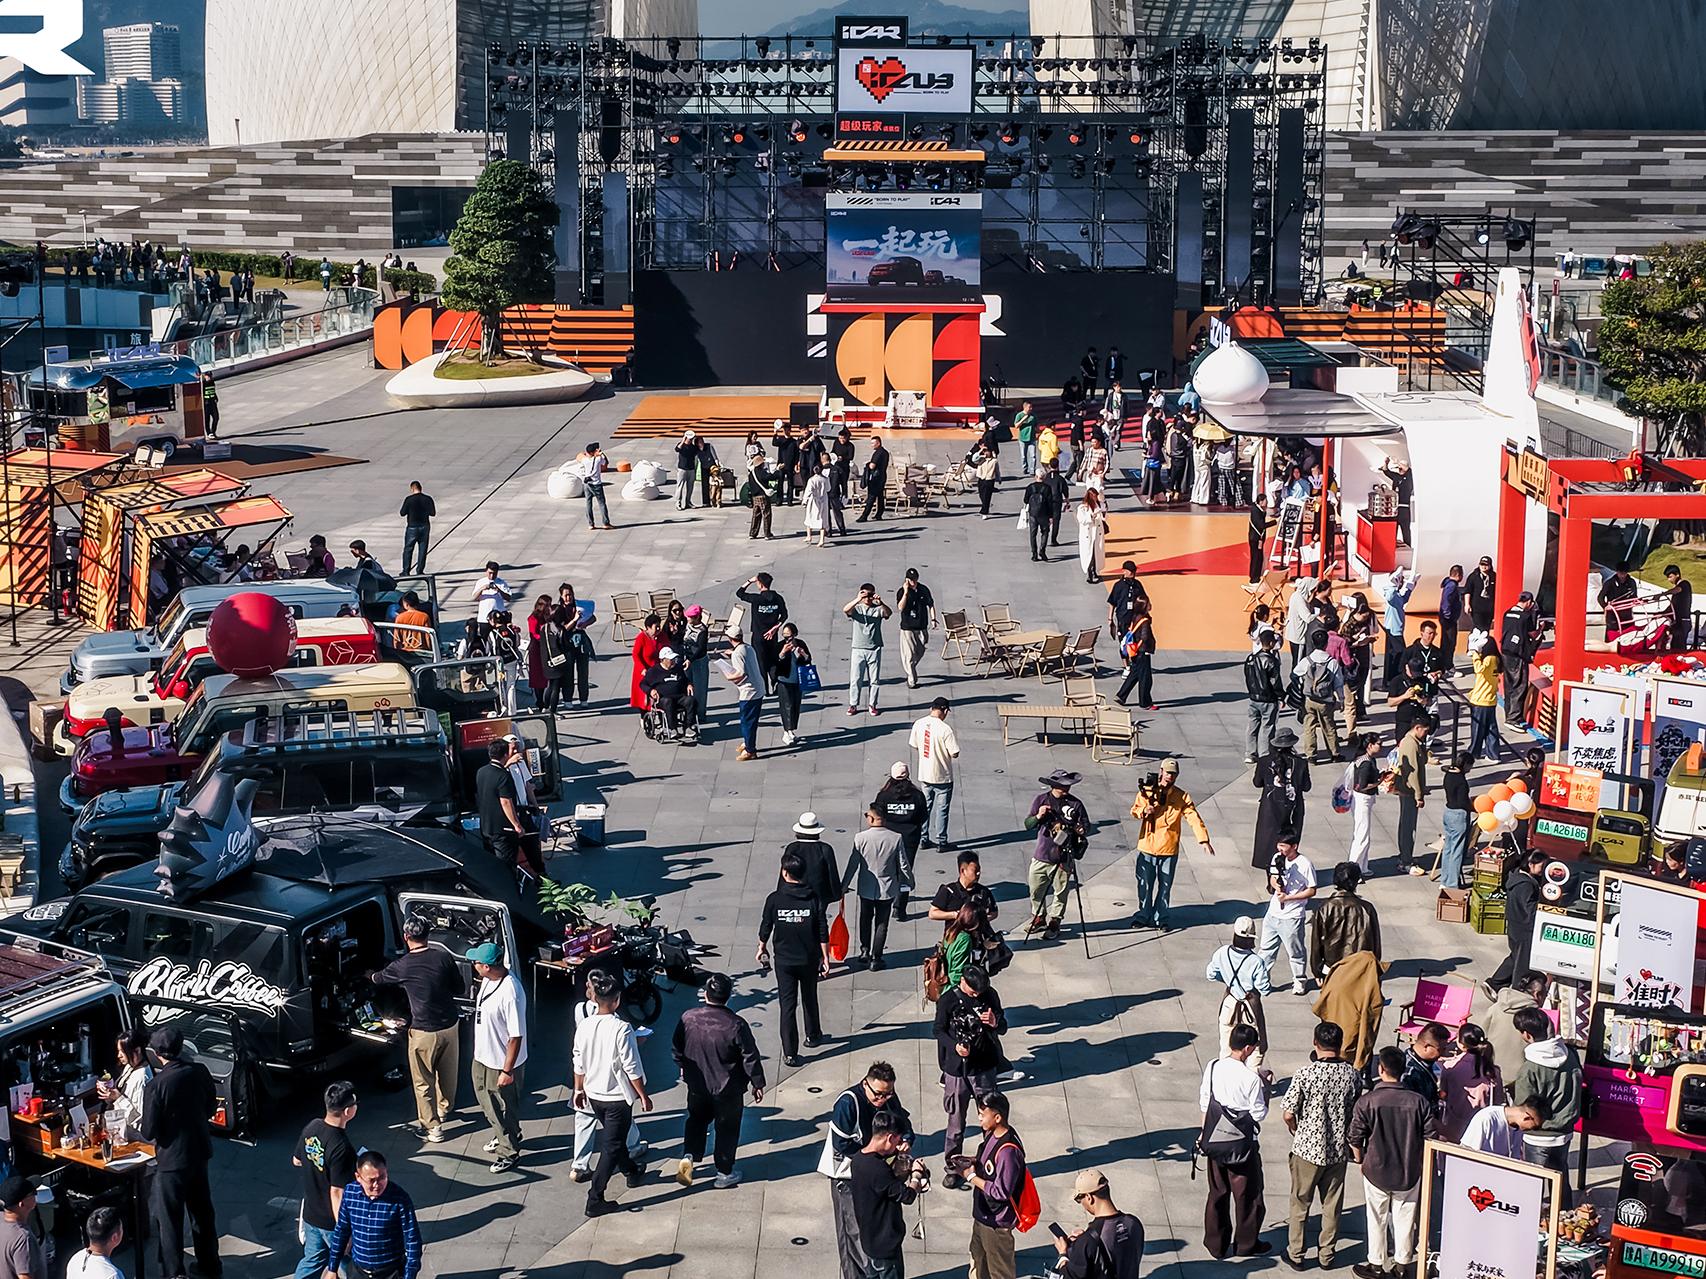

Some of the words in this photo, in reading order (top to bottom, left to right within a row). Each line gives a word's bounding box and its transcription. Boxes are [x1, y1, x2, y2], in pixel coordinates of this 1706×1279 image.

[842, 225, 959, 261] 一起玩
[1553, 824, 1587, 840] A26186
[1609, 1093, 1646, 1105] MARKET
[1649, 1250, 1705, 1275] A99919
